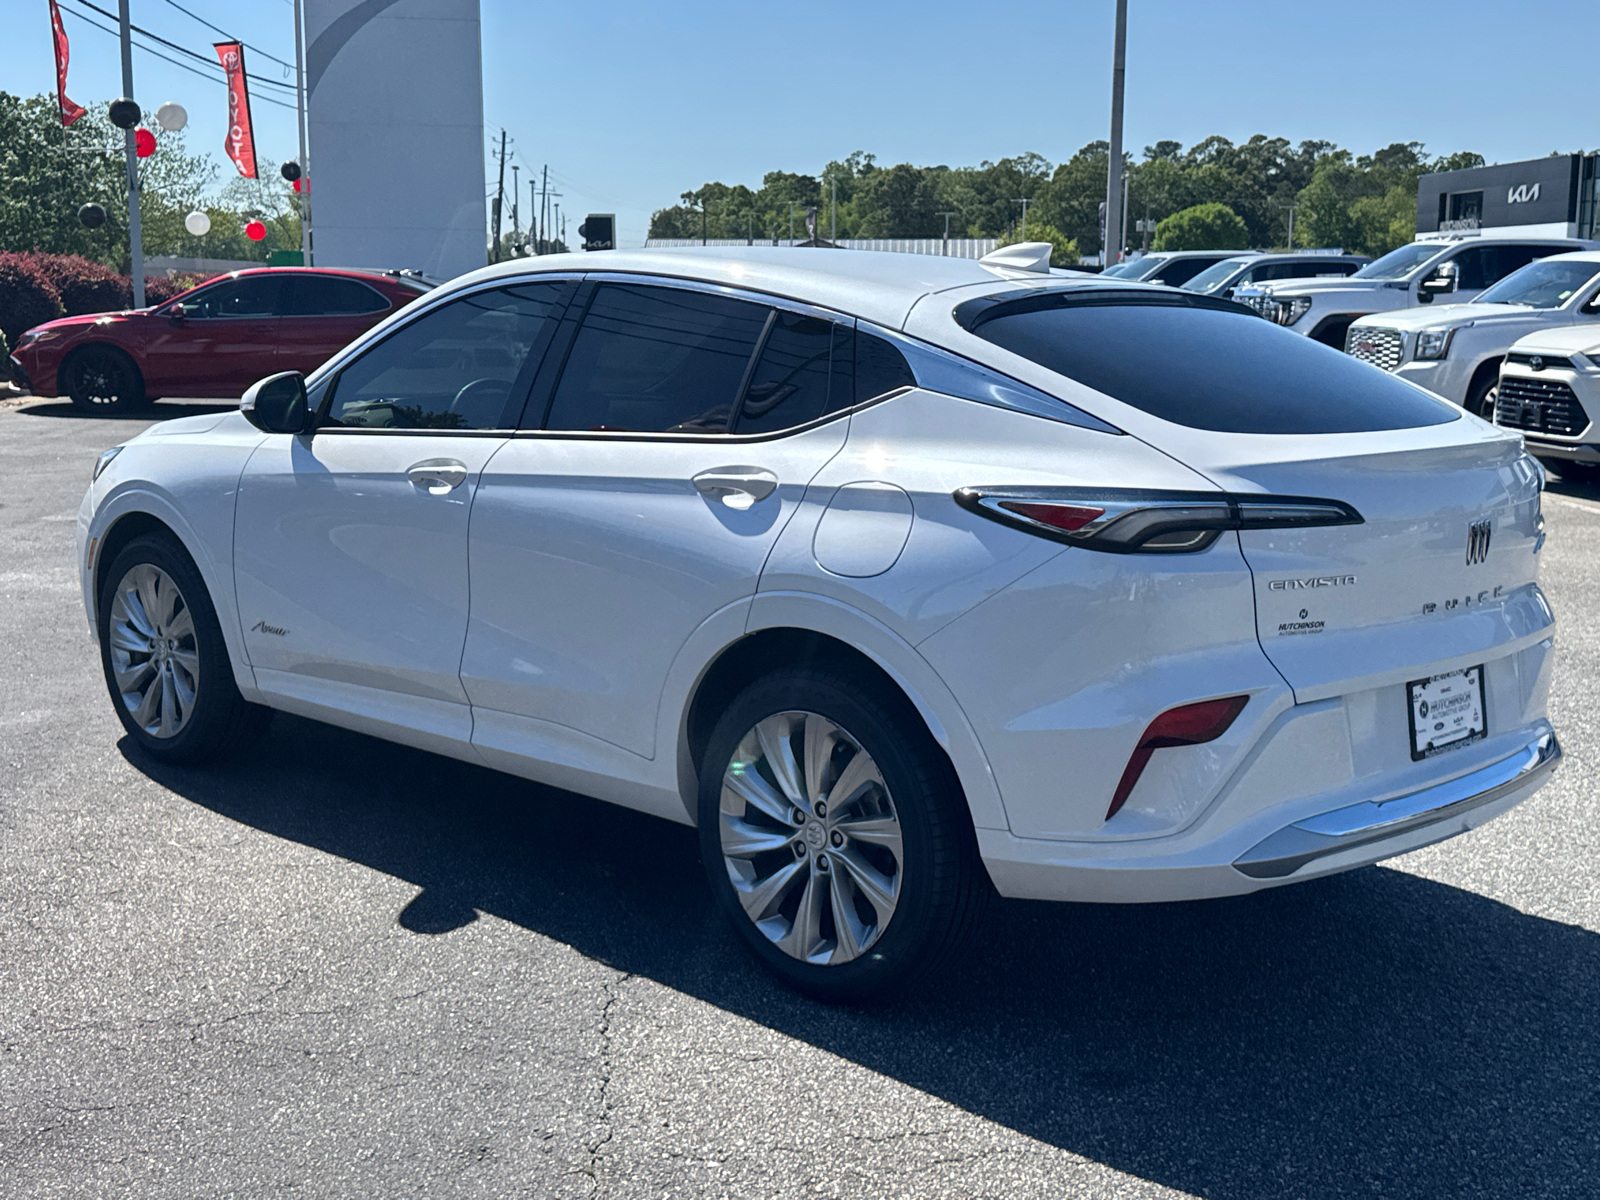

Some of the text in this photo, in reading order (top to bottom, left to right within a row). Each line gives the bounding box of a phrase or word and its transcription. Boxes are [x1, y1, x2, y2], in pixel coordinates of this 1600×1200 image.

[228, 74, 247, 174] TOYOTA
[1507, 183, 1540, 204] KIA
[587, 240, 612, 249] KIA
[1268, 574, 1358, 592] ENVISTA
[1422, 585, 1503, 615] BUICK
[1278, 620, 1326, 631] HUTCHINSON
[1430, 690, 1472, 713] HUTCHINSON
